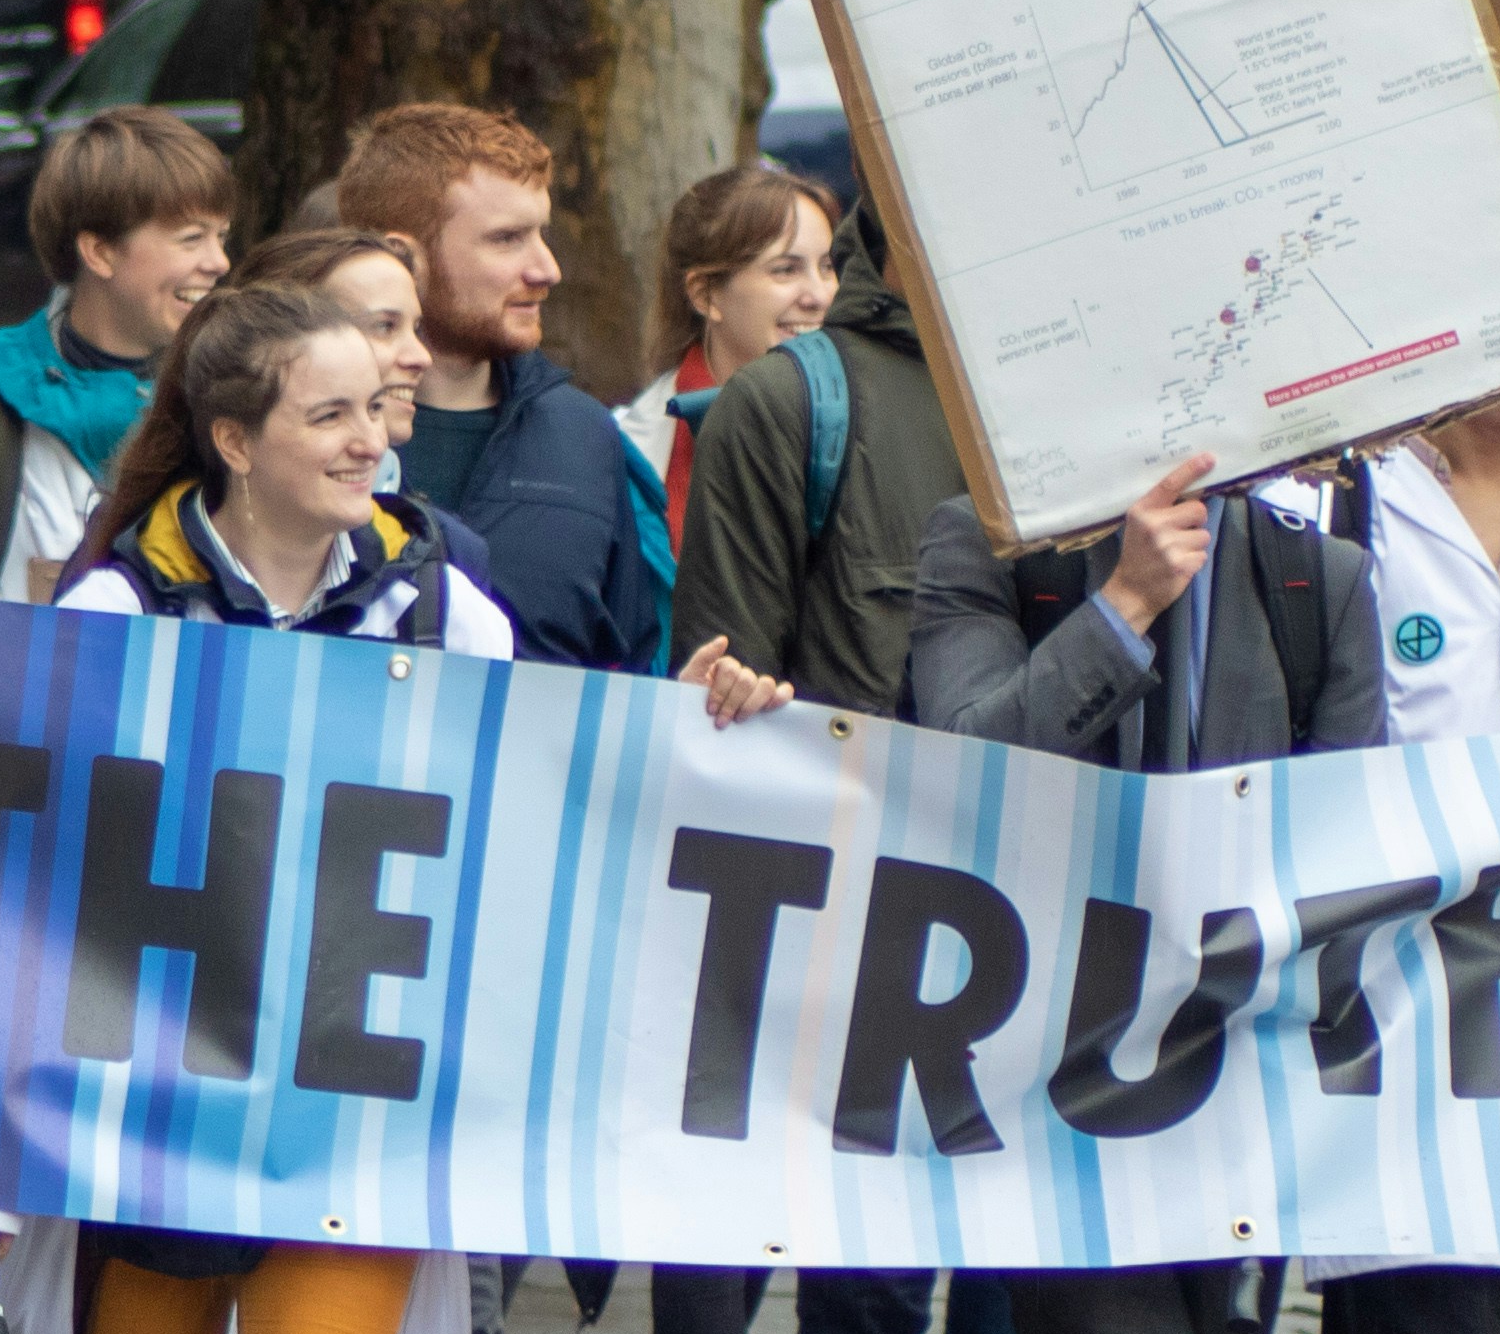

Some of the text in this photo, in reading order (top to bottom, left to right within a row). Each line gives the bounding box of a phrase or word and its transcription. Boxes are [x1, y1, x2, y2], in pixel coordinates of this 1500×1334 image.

[1234, 11, 1327, 48] World at net-zero in
[1267, 30, 1314, 53] limiting to
[926, 48, 966, 71] Global
[1272, 47, 1303, 66] highly
[1303, 39, 1329, 55] likely
[1415, 53, 1472, 79] IPCC Special
[912, 50, 1018, 93] emissions (billions
[923, 68, 1018, 107] of tons per year)
[1254, 55, 1347, 93] World at net-zero in
[1287, 74, 1335, 97] limiting to
[1376, 63, 1484, 105] Report on warming
[1291, 93, 1317, 110] fairly
[1317, 85, 1343, 102] likely
[1059, 154, 1072, 166] 10
[1182, 163, 1208, 179] 2020
[1316, 119, 1342, 134] 2100
[1120, 223, 1146, 242] The
[1147, 215, 1170, 232] link
[1173, 210, 1187, 224] to
[1188, 195, 1231, 220] break:
[1279, 166, 1326, 190] money
[1022, 323, 1050, 341] (tons
[1050, 317, 1069, 332] per
[997, 329, 1081, 365] person per year)
[1267, 334, 1458, 405] Here is where the whole world needs to be
[1259, 417, 1340, 452] GDP per capita
